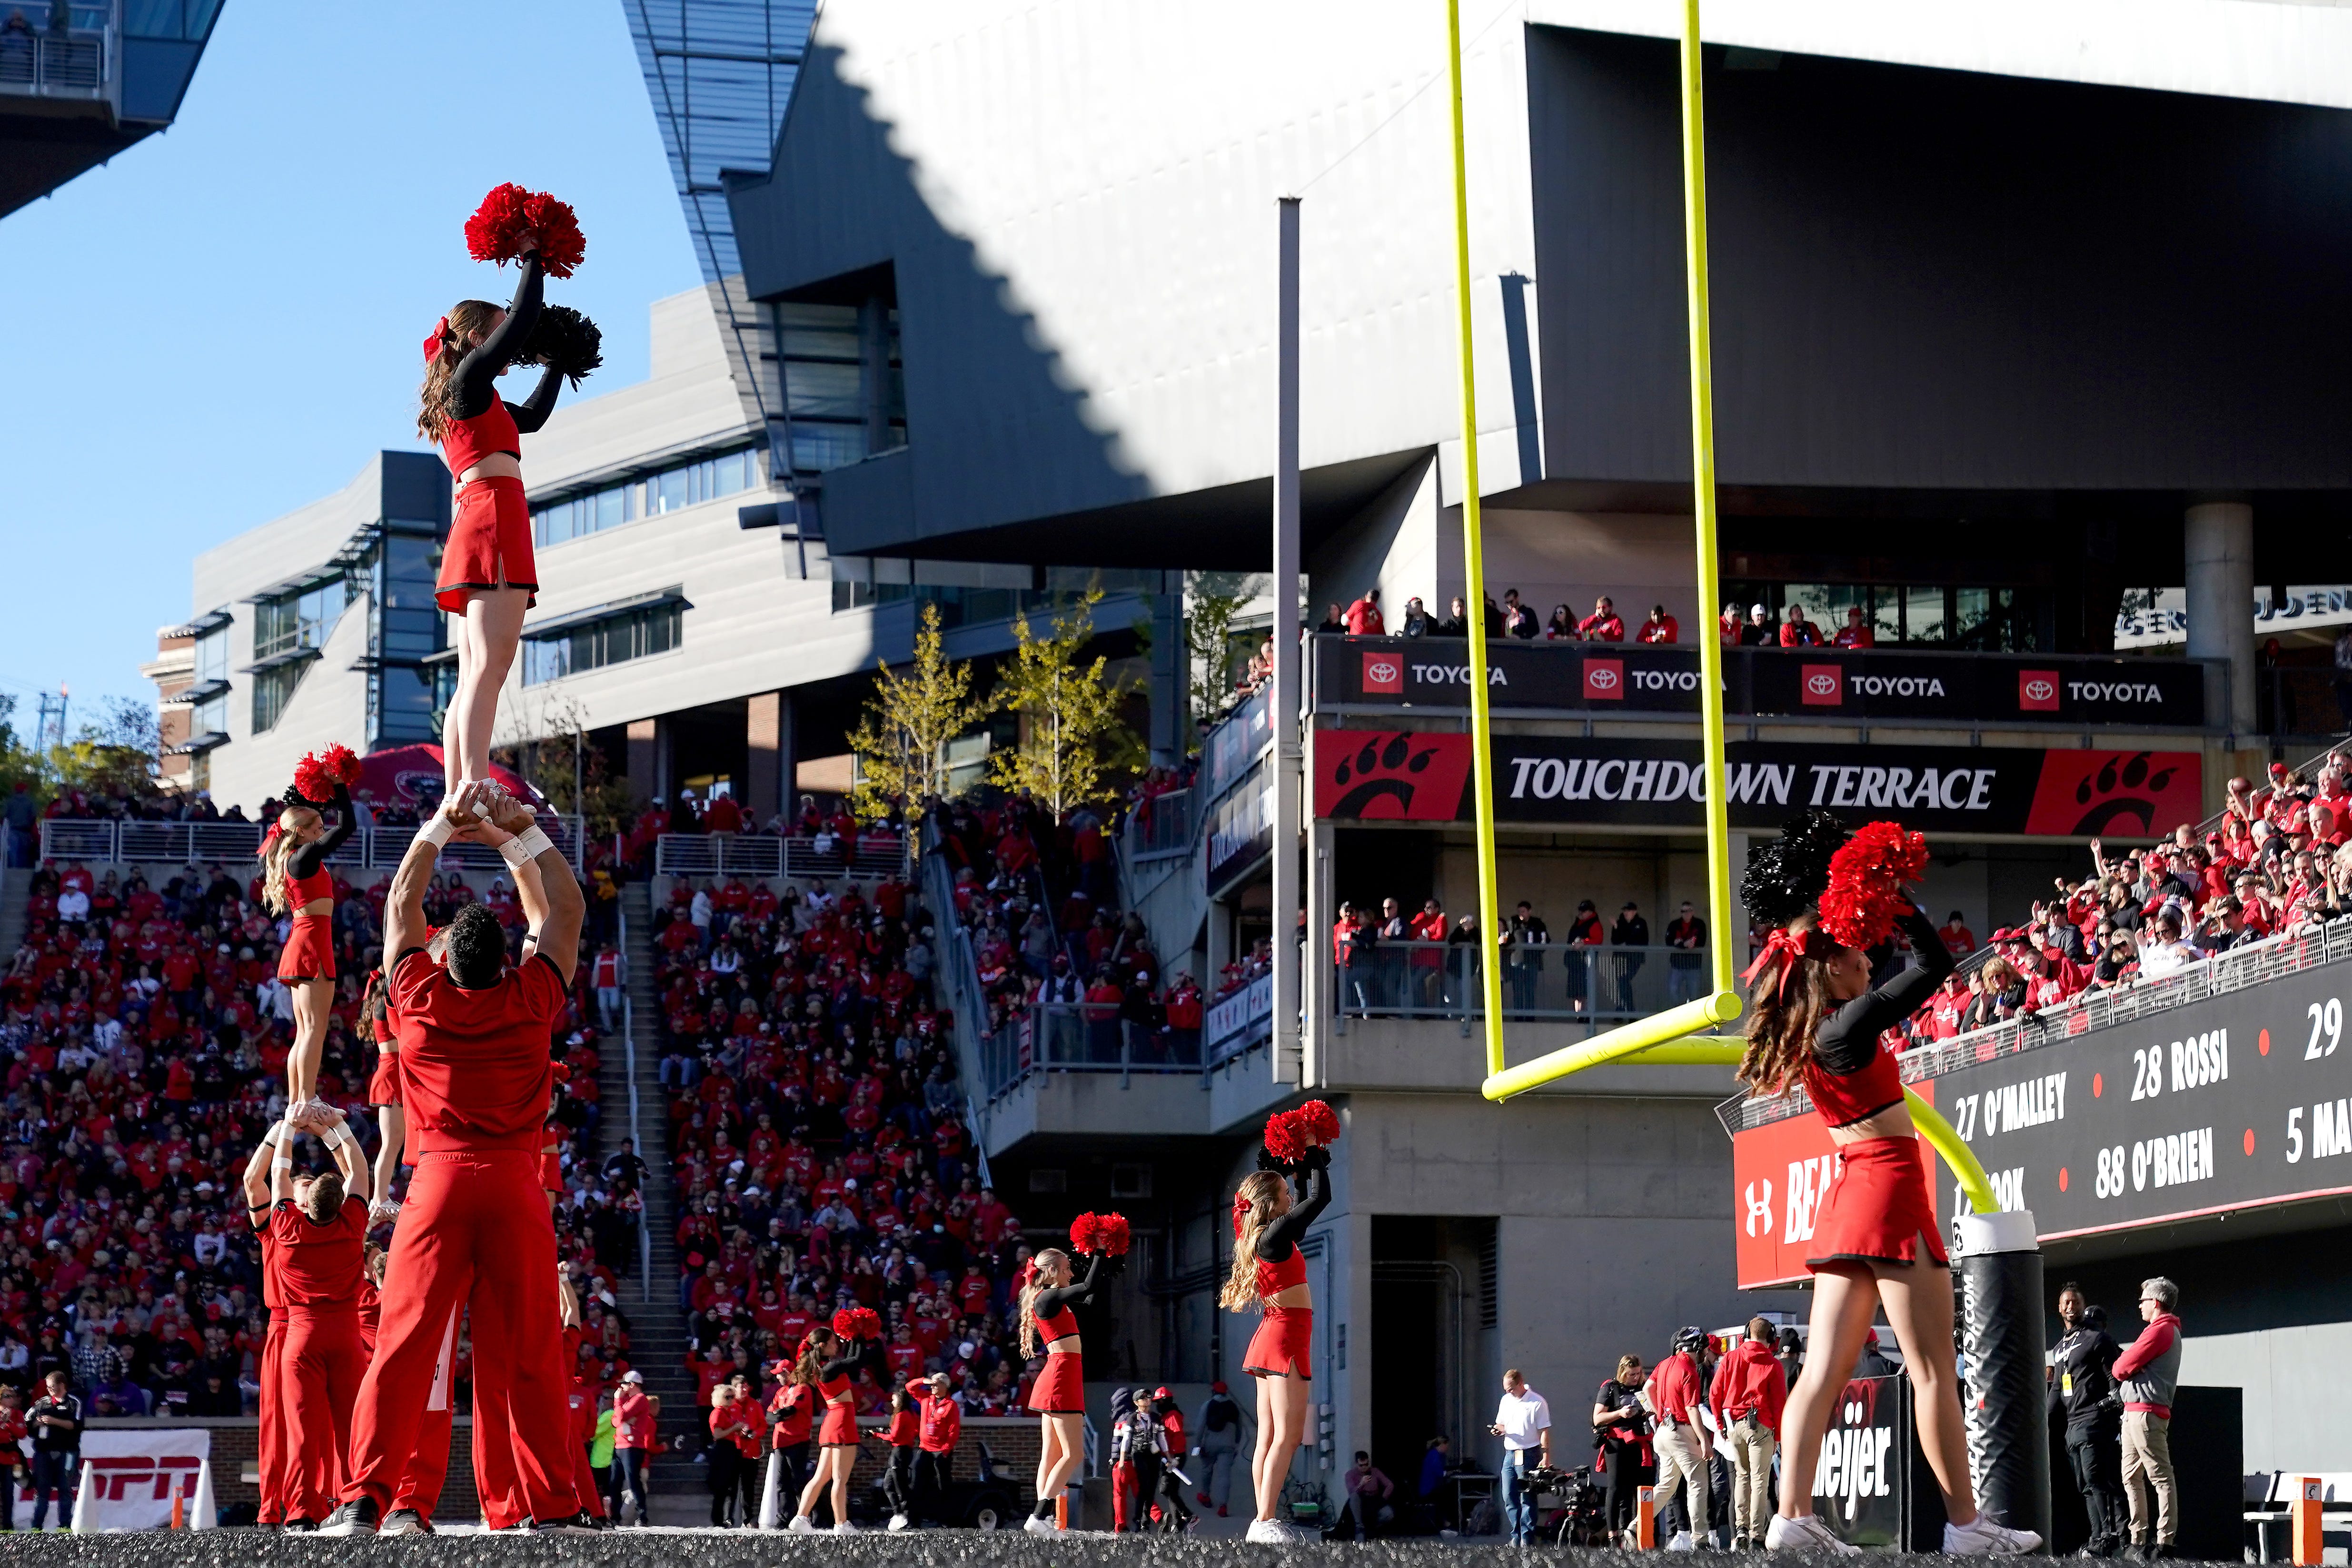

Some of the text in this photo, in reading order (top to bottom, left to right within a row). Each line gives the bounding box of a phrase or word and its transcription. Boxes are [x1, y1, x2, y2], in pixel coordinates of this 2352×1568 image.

[1411, 665, 1508, 685] TOYOA
[1631, 671, 1727, 691] TOYO
[1851, 675, 1945, 697] TOYOTA
[2068, 681, 2163, 703] TOYOTA
[1510, 757, 1996, 810] TOUCHDOWN TERRACE
[2304, 997, 2342, 1061] 29
[2131, 1028, 2228, 1102] 28 ROSSI
[1955, 1071, 2067, 1142] 27 O'MALLEY
[2286, 1097, 2352, 1164] 5 MA
[2095, 1126, 2214, 1199] 88 O'BRIEN
[1986, 1166, 2025, 1213] OOK
